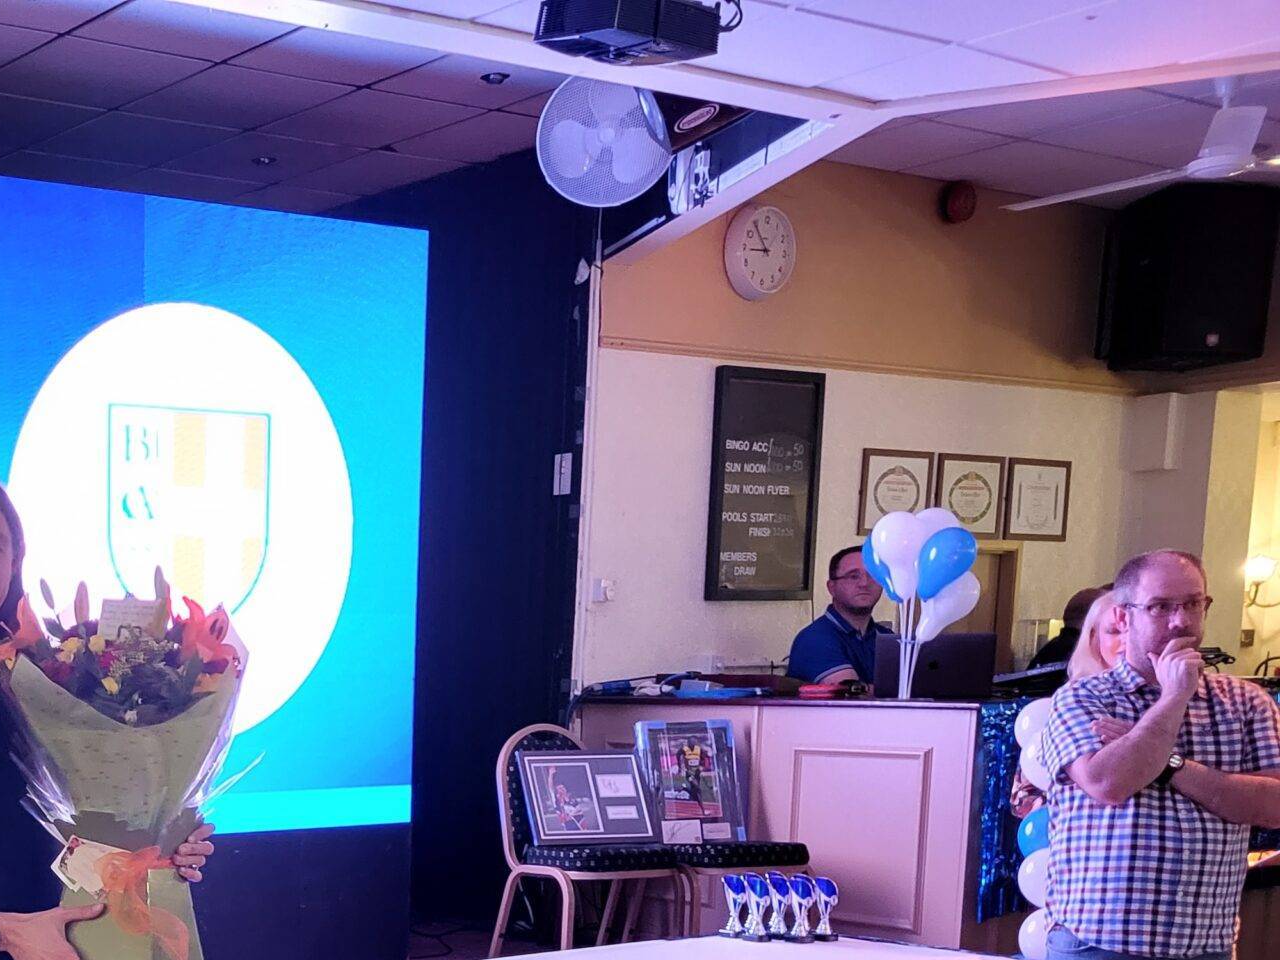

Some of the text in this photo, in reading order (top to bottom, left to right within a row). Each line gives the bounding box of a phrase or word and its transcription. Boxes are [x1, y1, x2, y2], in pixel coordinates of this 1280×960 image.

[725, 439, 750, 451] BINGO
[751, 442, 768, 453] ACC
[725, 462, 741, 473] SUN
[744, 462, 767, 473] NOON
[724, 484, 790, 496] SUN NOON FLYER
[722, 511, 748, 523] POOLS
[749, 512, 774, 523] START
[720, 551, 757, 562] MEMBERS
[733, 566, 756, 576] DRAW
